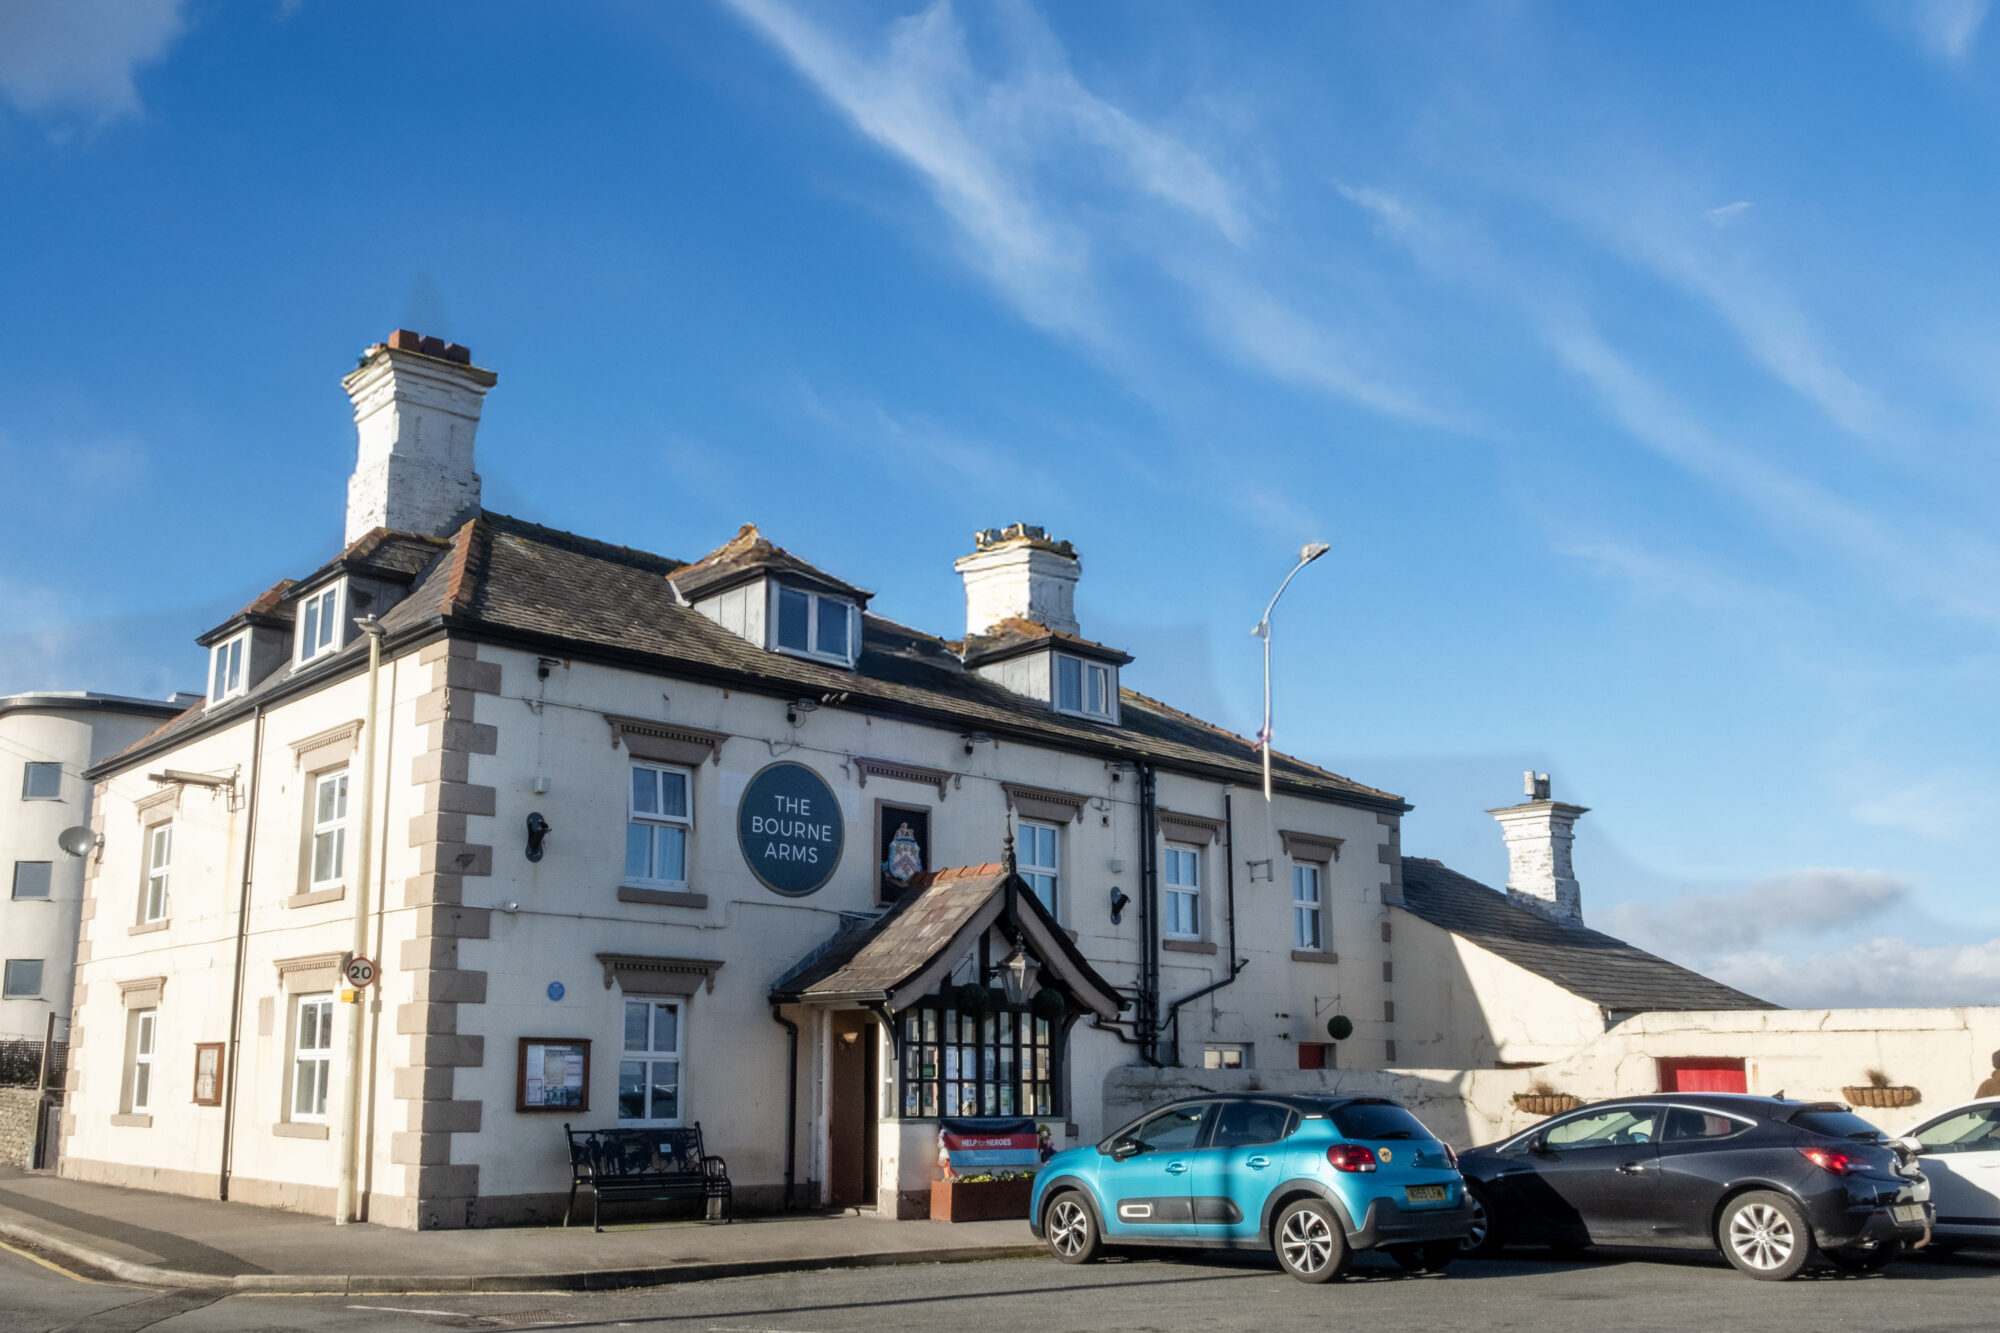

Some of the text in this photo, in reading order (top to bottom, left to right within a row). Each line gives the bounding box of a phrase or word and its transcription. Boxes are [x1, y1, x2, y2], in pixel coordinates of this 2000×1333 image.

[774, 795, 811, 816] THE
[752, 815, 832, 842] BOURNE
[763, 842, 818, 864] ARMS
[350, 966, 372, 979] 20
[961, 1139, 978, 1147] HELP
[987, 1138, 1011, 1147] HEROES
